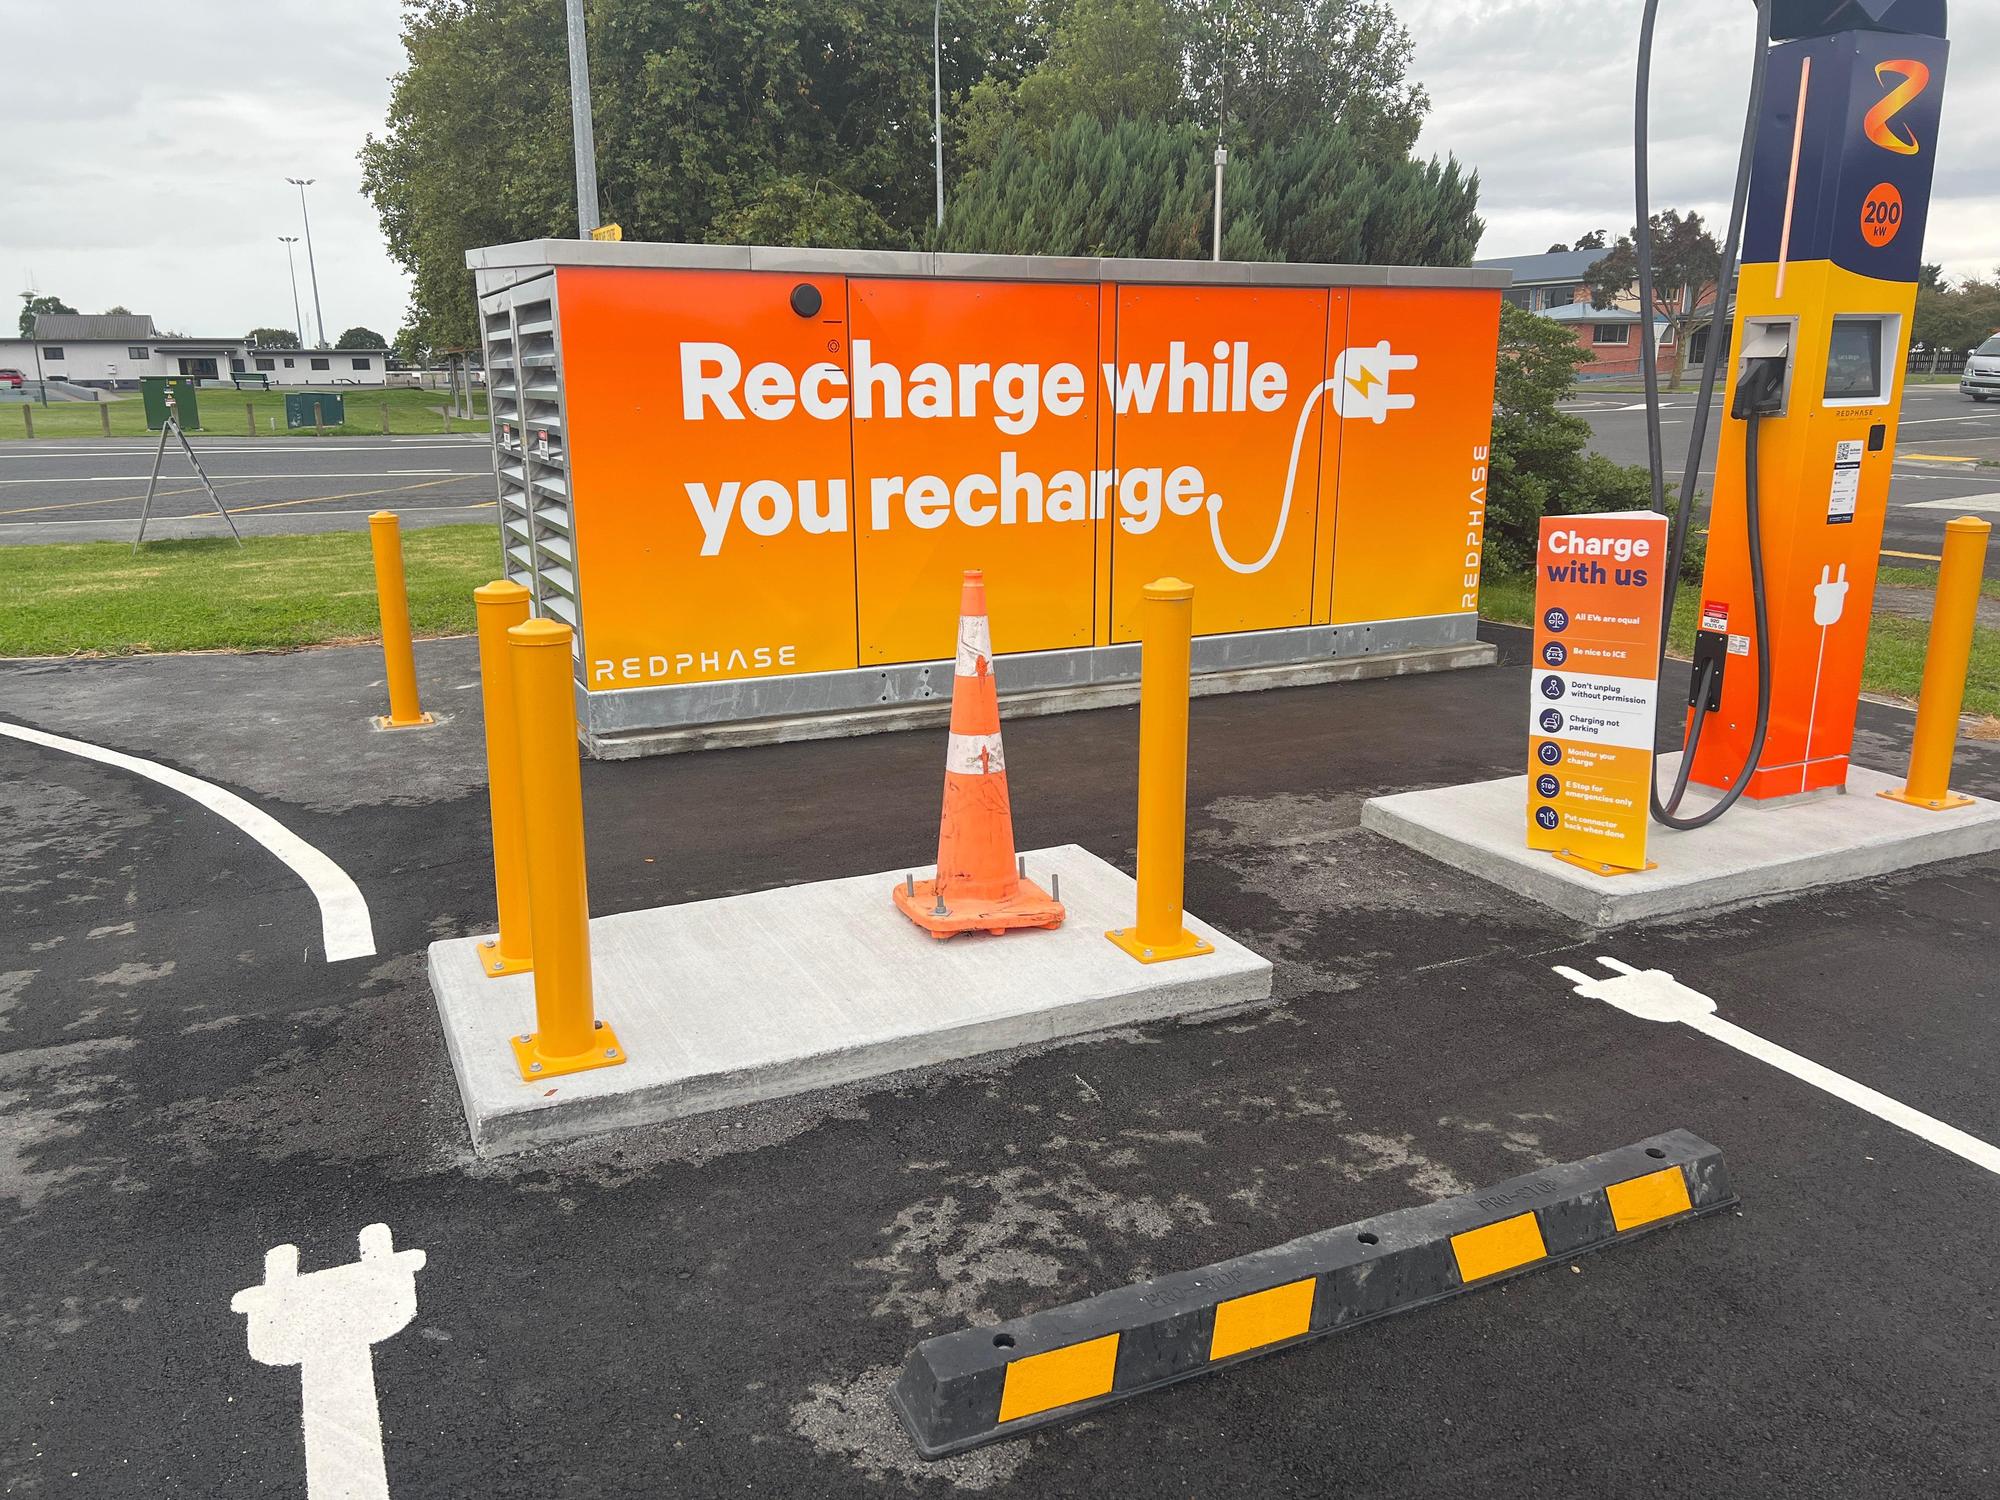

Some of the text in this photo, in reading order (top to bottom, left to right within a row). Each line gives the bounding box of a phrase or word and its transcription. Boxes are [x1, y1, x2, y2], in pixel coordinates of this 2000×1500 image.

[1864, 200, 1901, 224] 200
[1873, 226, 1887, 237] kW
[679, 339, 1288, 436] Recharge while
[1836, 409, 1873, 417] REDPHASE
[684, 452, 1205, 556] you recharge
[1461, 445, 1488, 609] REDPHASE
[1548, 530, 1650, 562] Charge
[1547, 560, 1648, 586] with us
[1575, 613, 1586, 621] All
[1587, 614, 1601, 622] EVs
[1617, 617, 1640, 625] equal
[1573, 647, 1583, 655] Be
[1584, 648, 1601, 656] nice
[596, 645, 796, 682] REDPHASE
[1571, 681, 1621, 693] Don't unplug
[1571, 690, 1646, 705] without permission
[1570, 715, 1620, 727] Charging not
[1569, 724, 1598, 734] parking
[1567, 756, 1594, 767] charge
[1568, 748, 1616, 761] Monitor your
[1541, 782, 1555, 790] STOP
[1566, 780, 1571, 788] E
[1572, 782, 1590, 793] Stop
[1565, 791, 1632, 808] emergencies only
[1564, 813, 1617, 828] Put connector
[1564, 822, 1625, 839] back when done
